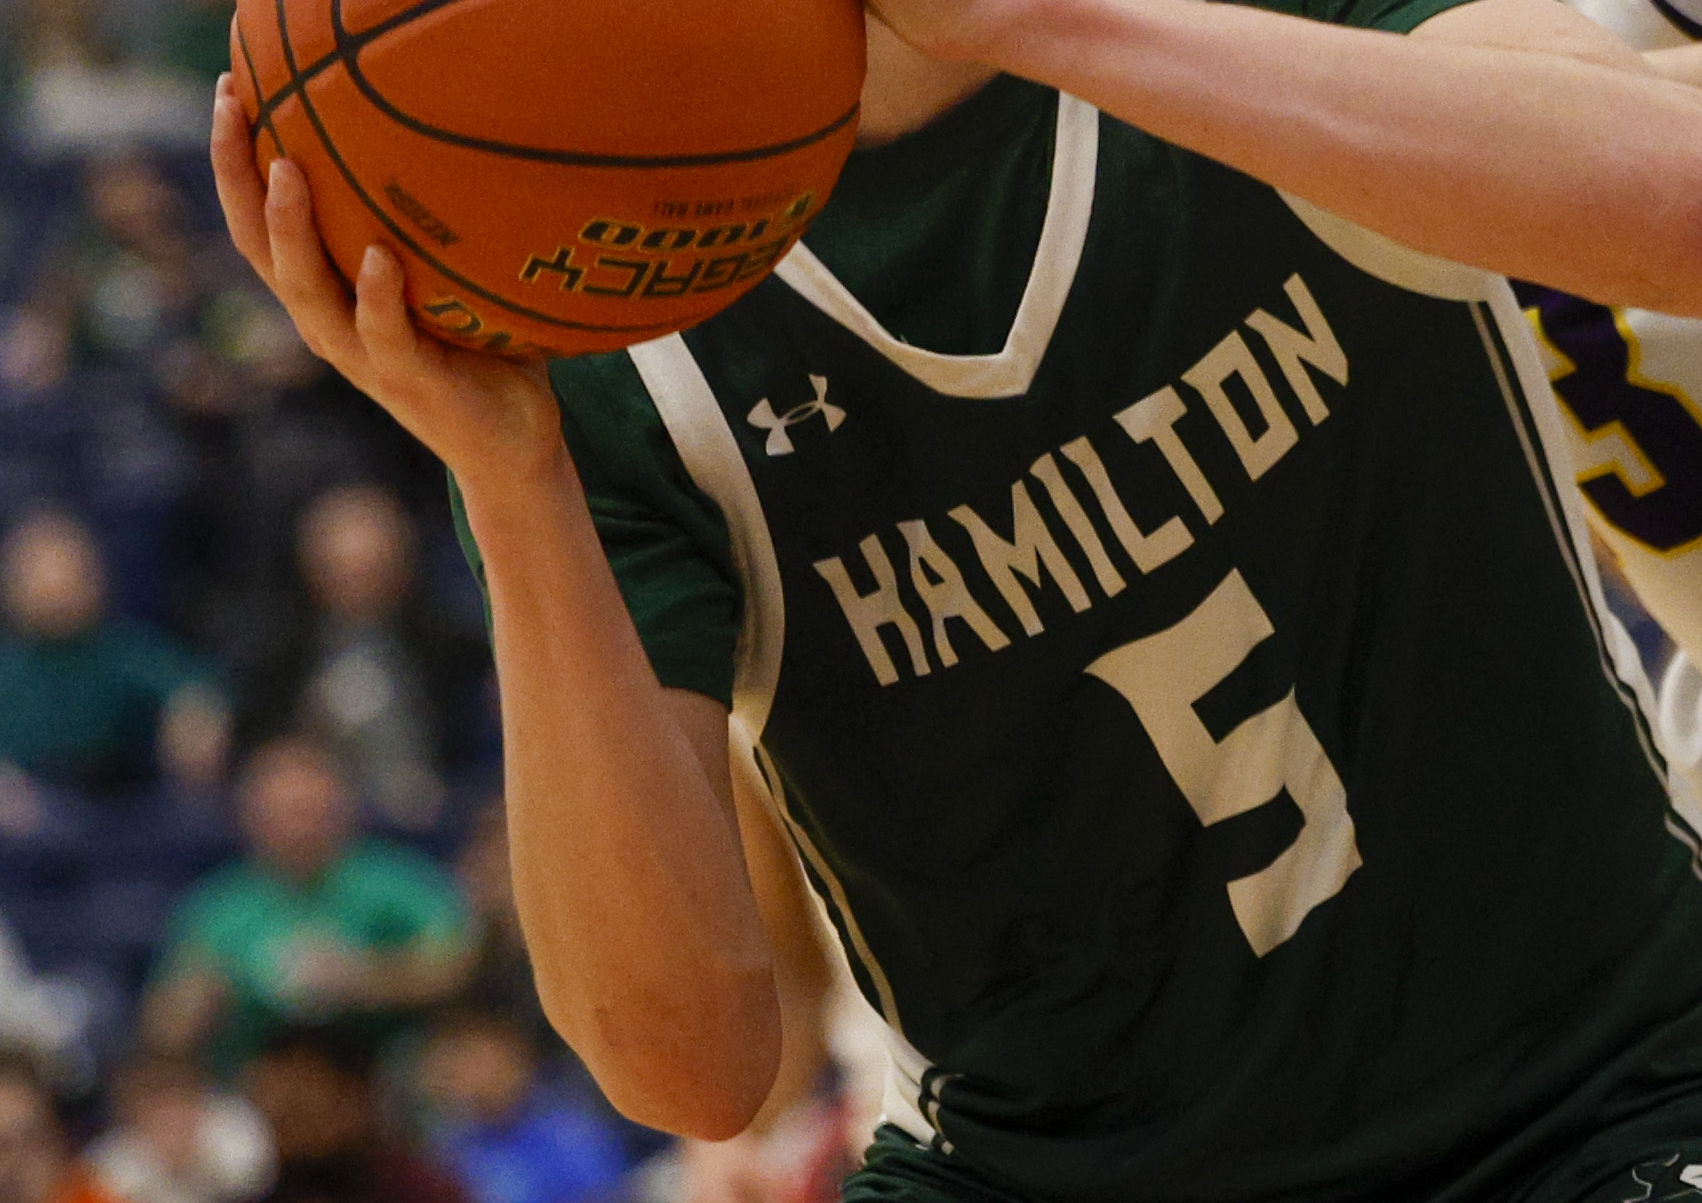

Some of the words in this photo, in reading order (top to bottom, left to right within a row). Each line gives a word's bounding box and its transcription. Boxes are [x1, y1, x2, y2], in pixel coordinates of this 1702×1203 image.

[519, 236, 788, 300] EGACY
[812, 272, 1348, 687] HAMILTON
[1082, 567, 1363, 957] 5
